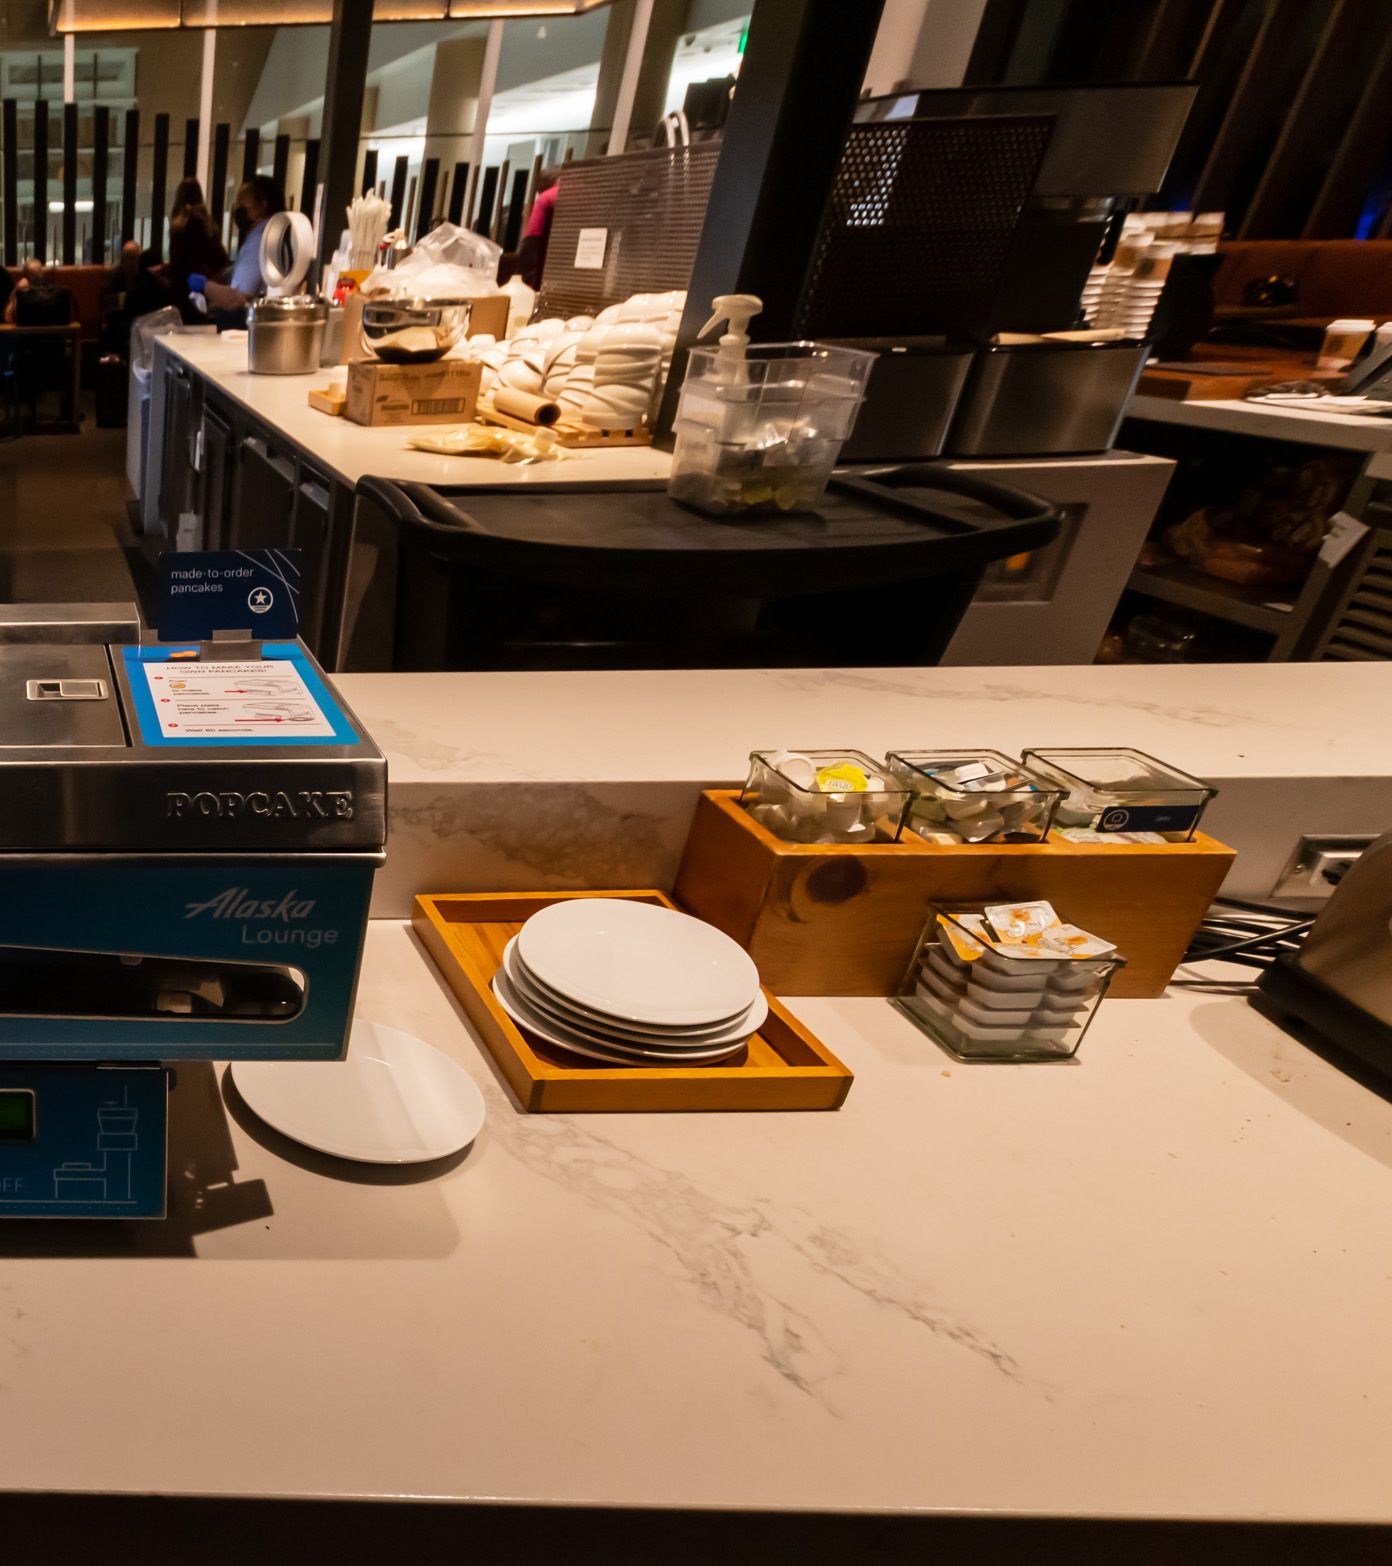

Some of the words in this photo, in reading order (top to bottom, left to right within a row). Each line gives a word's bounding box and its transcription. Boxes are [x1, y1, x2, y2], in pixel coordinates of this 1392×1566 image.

[171, 567, 255, 579] made-to-order
[171, 582, 223, 595] pancakes
[166, 791, 354, 818] POPCAKE
[182, 886, 317, 923] Alaska
[241, 924, 339, 949] Lounge
